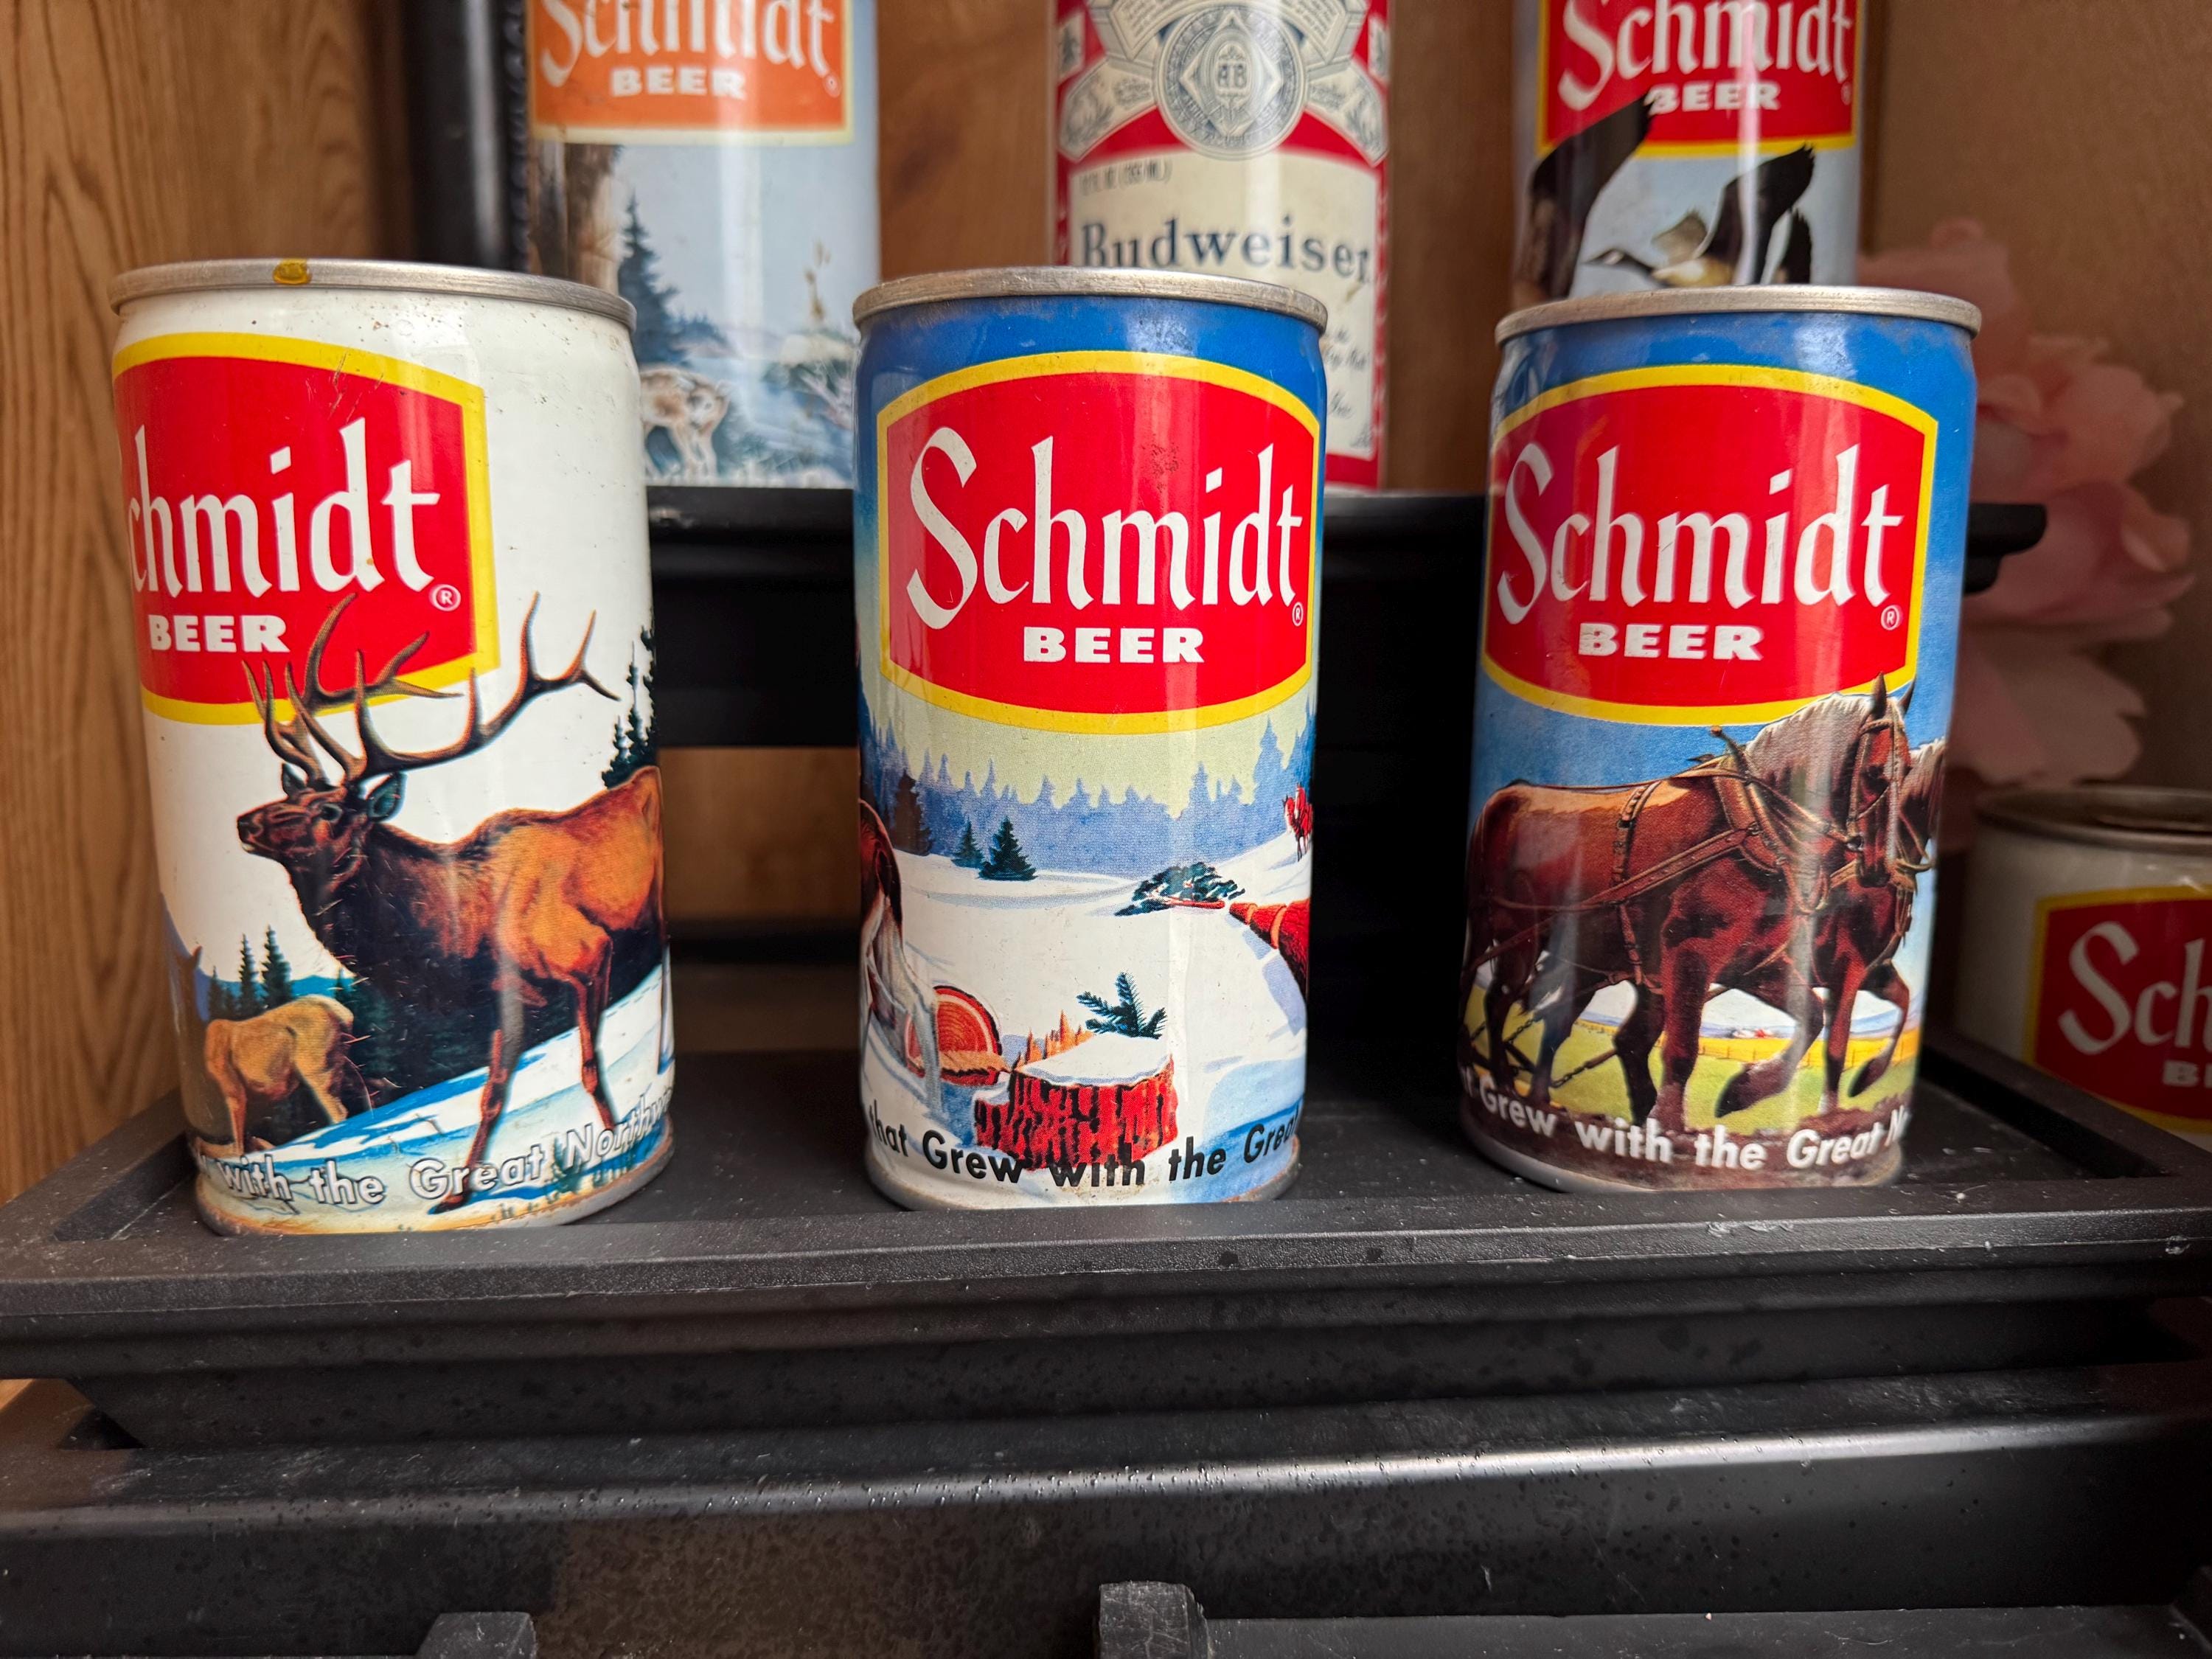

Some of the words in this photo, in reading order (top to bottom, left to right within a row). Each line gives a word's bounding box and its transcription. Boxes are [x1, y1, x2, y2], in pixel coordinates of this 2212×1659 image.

[611, 66, 746, 100] BEER
[1557, 0, 1852, 111] Schmidt
[1644, 80, 1781, 116] BEER
[1081, 214, 1371, 284] Budweiser
[906, 427, 1302, 630] Schmidt
[1497, 442, 1904, 625] Schmidt
[149, 615, 291, 653] BEER
[1023, 627, 1204, 664] BEER
[1579, 622, 1763, 661] BEER
[869, 1099, 909, 1158] that
[922, 1129, 1023, 1183] Grew
[1049, 1141, 1146, 1187] with
[1169, 1135, 1227, 1181] the
[1479, 1074, 1557, 1138] Grew
[1574, 1117, 1674, 1165] with
[1694, 1124, 1767, 1170] the
[1786, 1121, 1887, 1169] Great
[215, 1153, 293, 1202] with
[309, 1159, 386, 1206] the
[410, 1144, 548, 1200] Great
